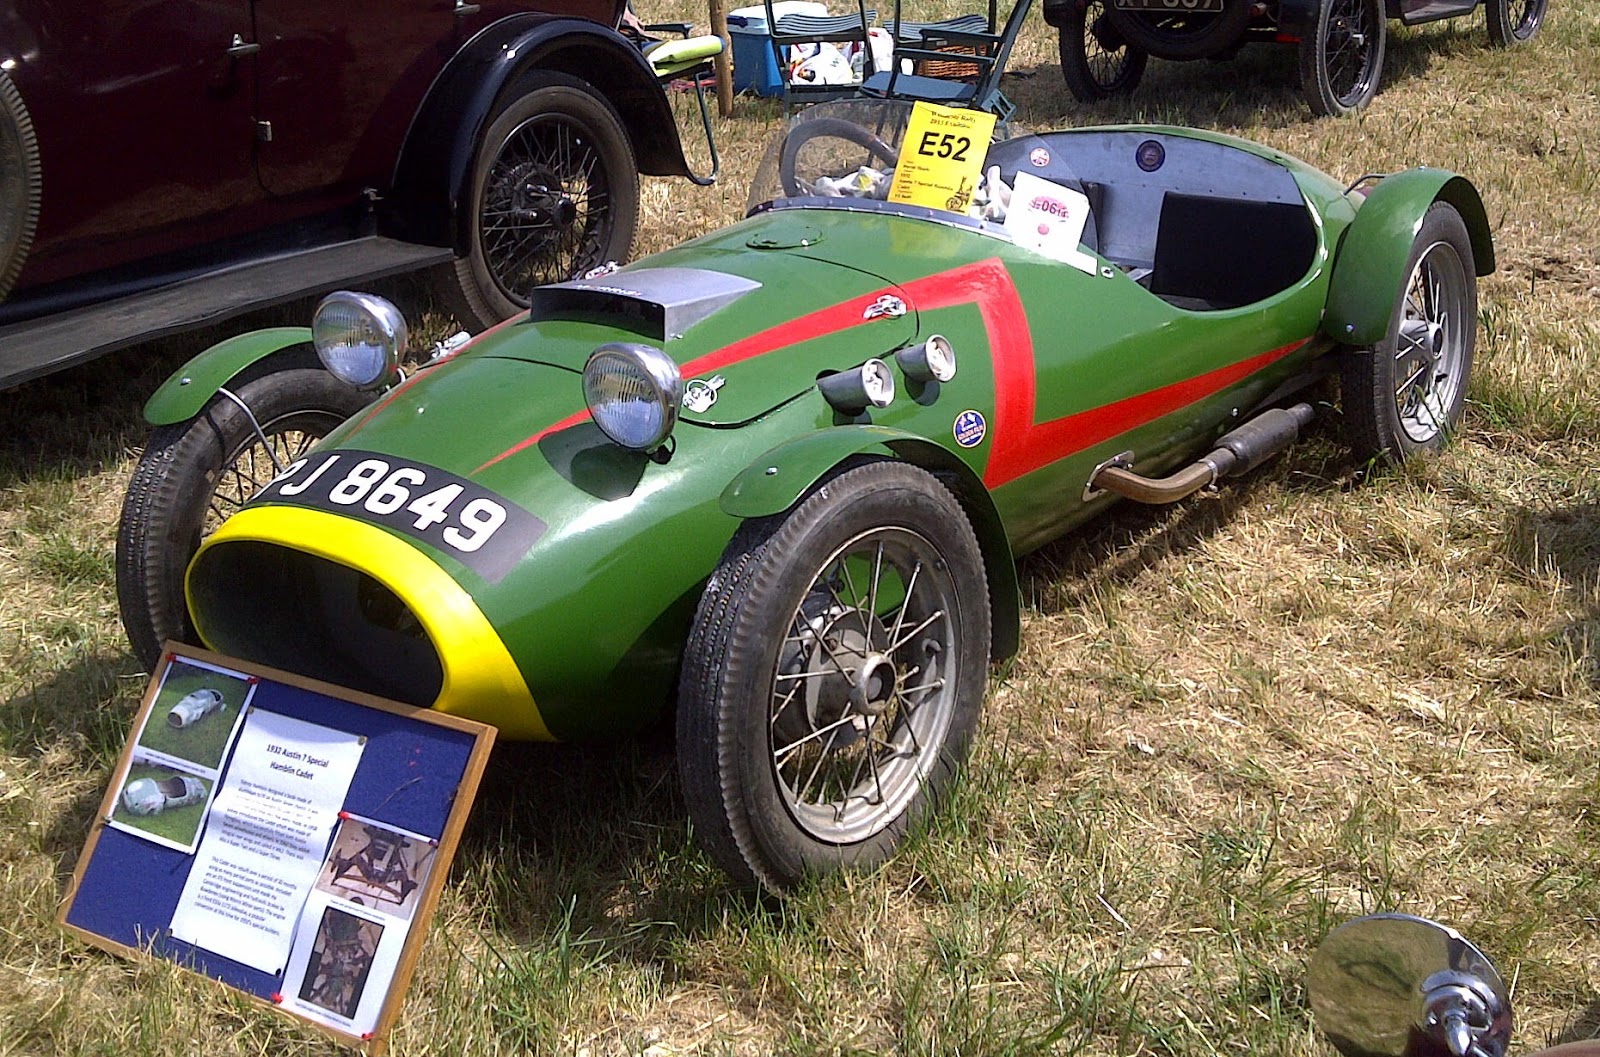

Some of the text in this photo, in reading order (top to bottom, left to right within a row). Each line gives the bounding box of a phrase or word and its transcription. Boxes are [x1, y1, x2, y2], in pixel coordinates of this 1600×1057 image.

[918, 131, 971, 162] E52
[328, 458, 508, 553] 8649
[266, 743, 330, 768] 1932 Austin 7 Special
[269, 761, 314, 780] Hamblin Cadet
